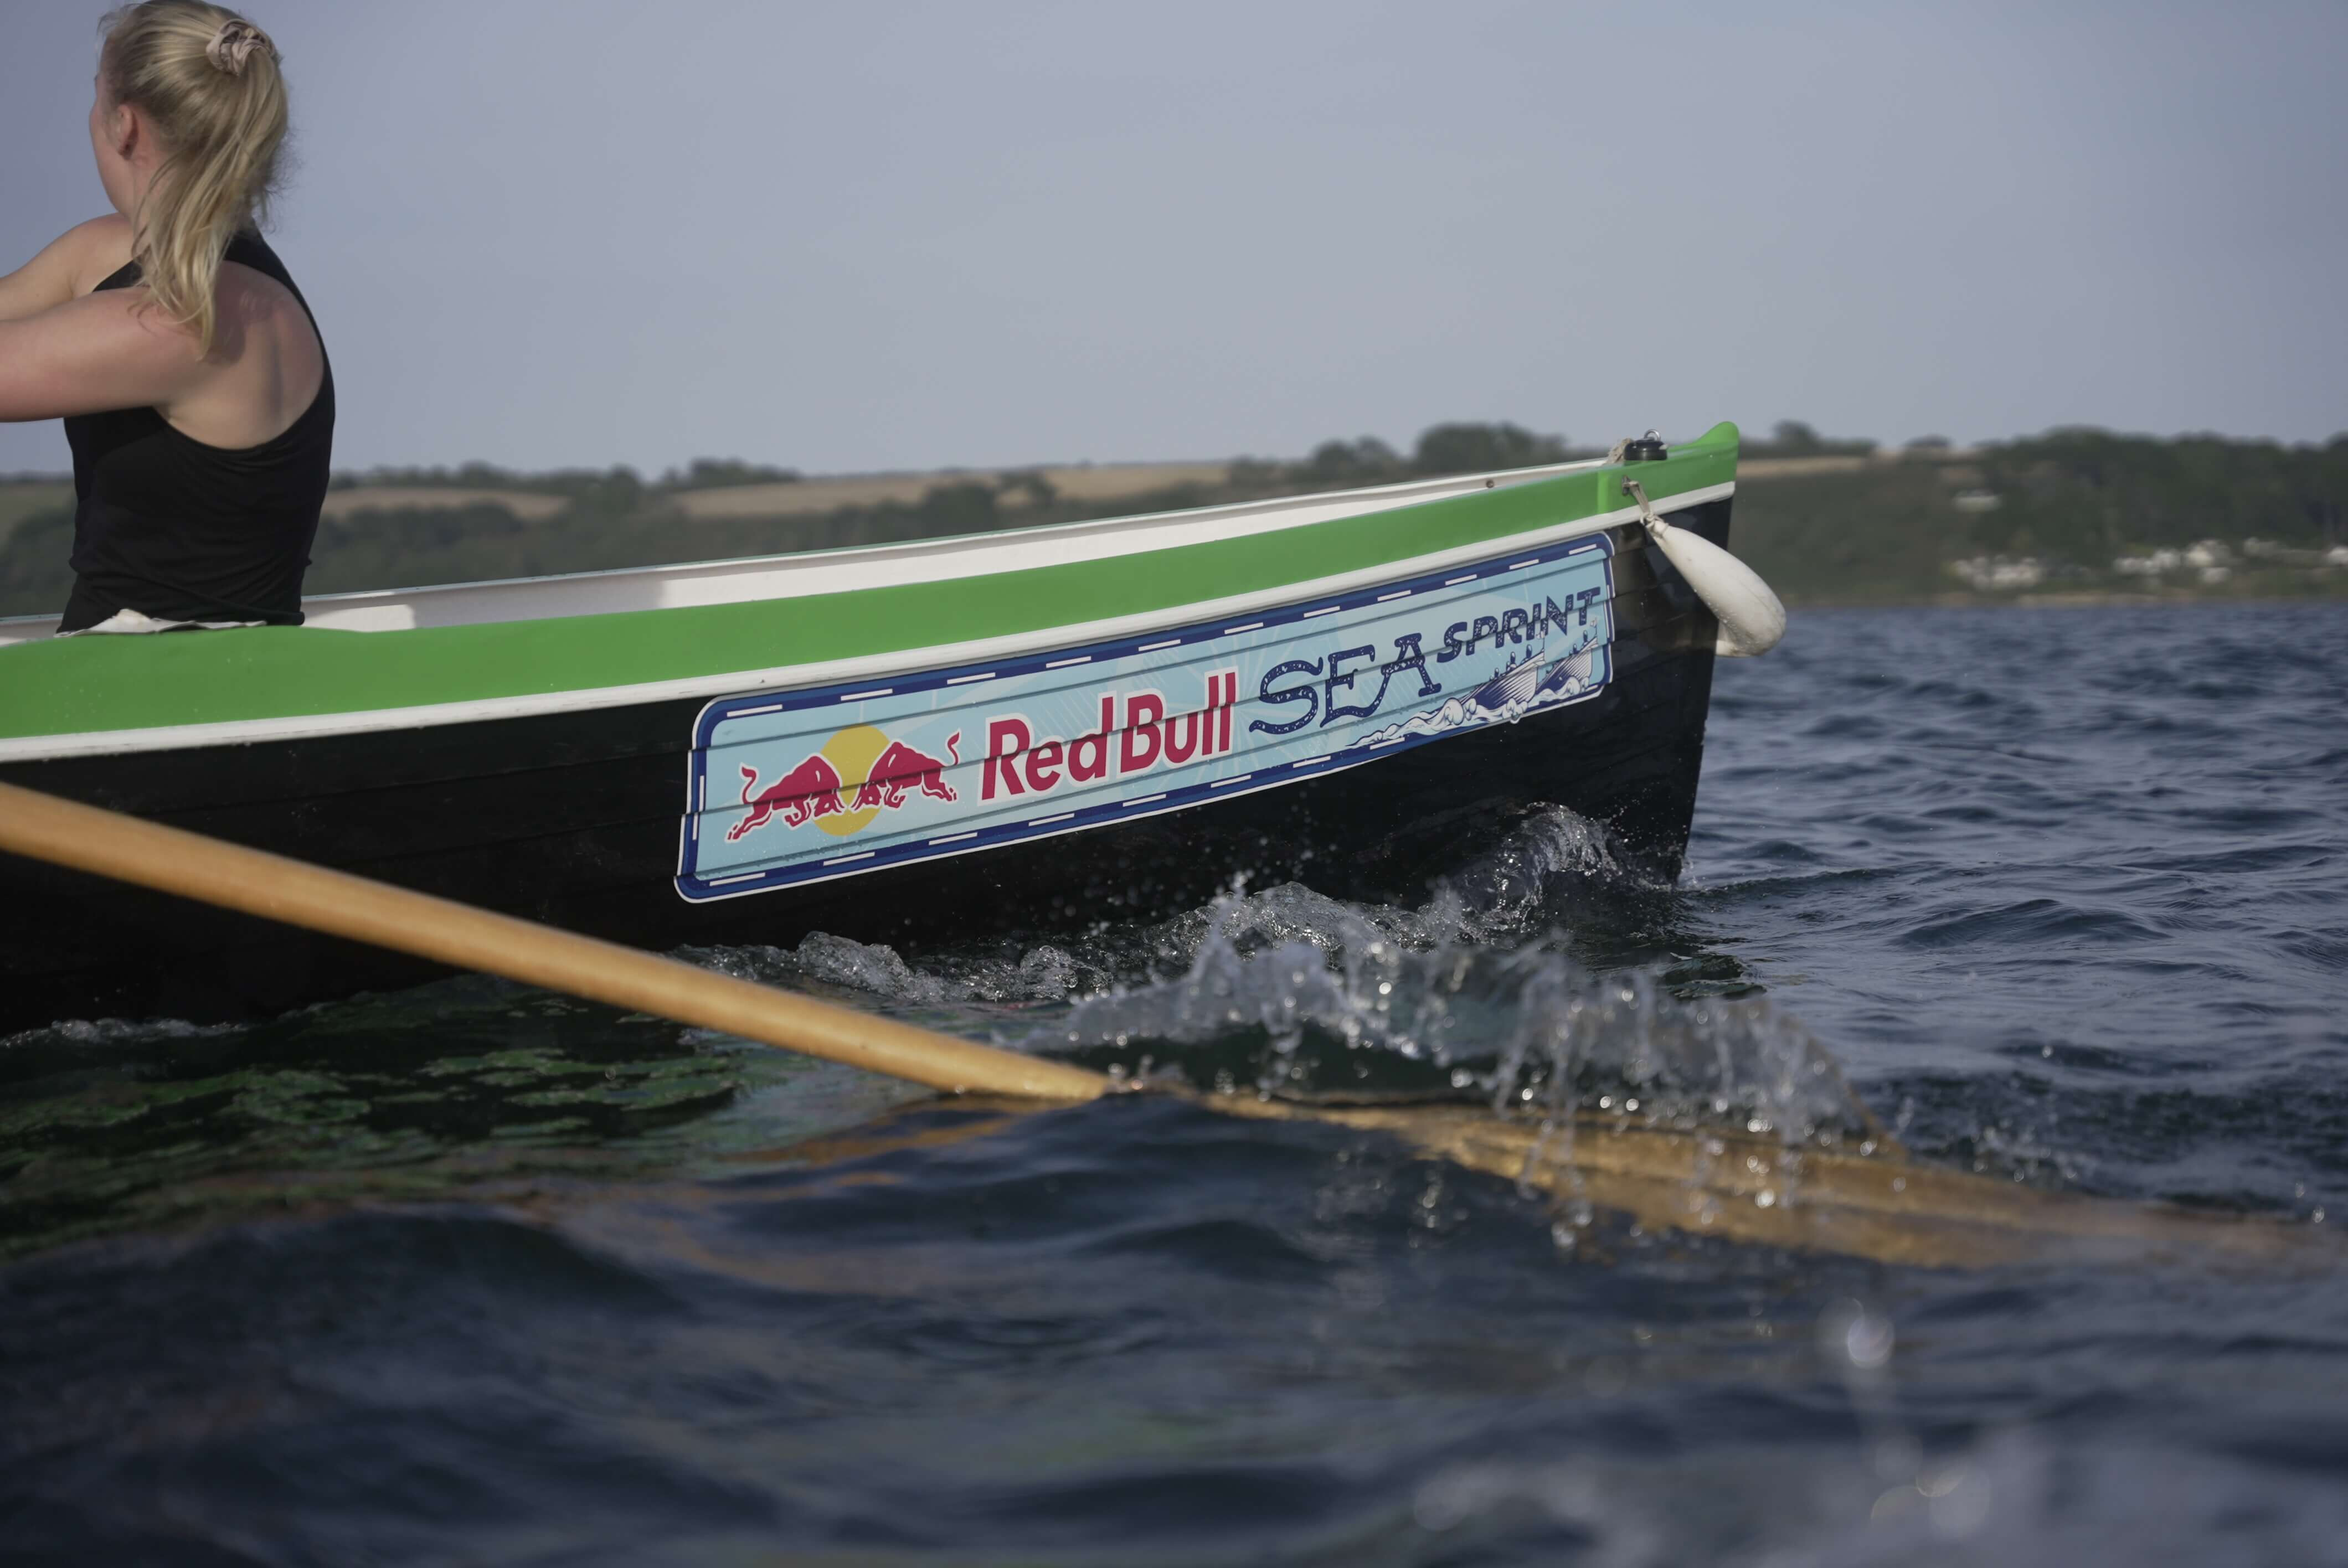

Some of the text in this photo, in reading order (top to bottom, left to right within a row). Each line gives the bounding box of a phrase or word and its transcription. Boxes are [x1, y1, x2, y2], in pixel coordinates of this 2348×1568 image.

[981, 587, 1600, 801] Red Bull SEA SPRINT
